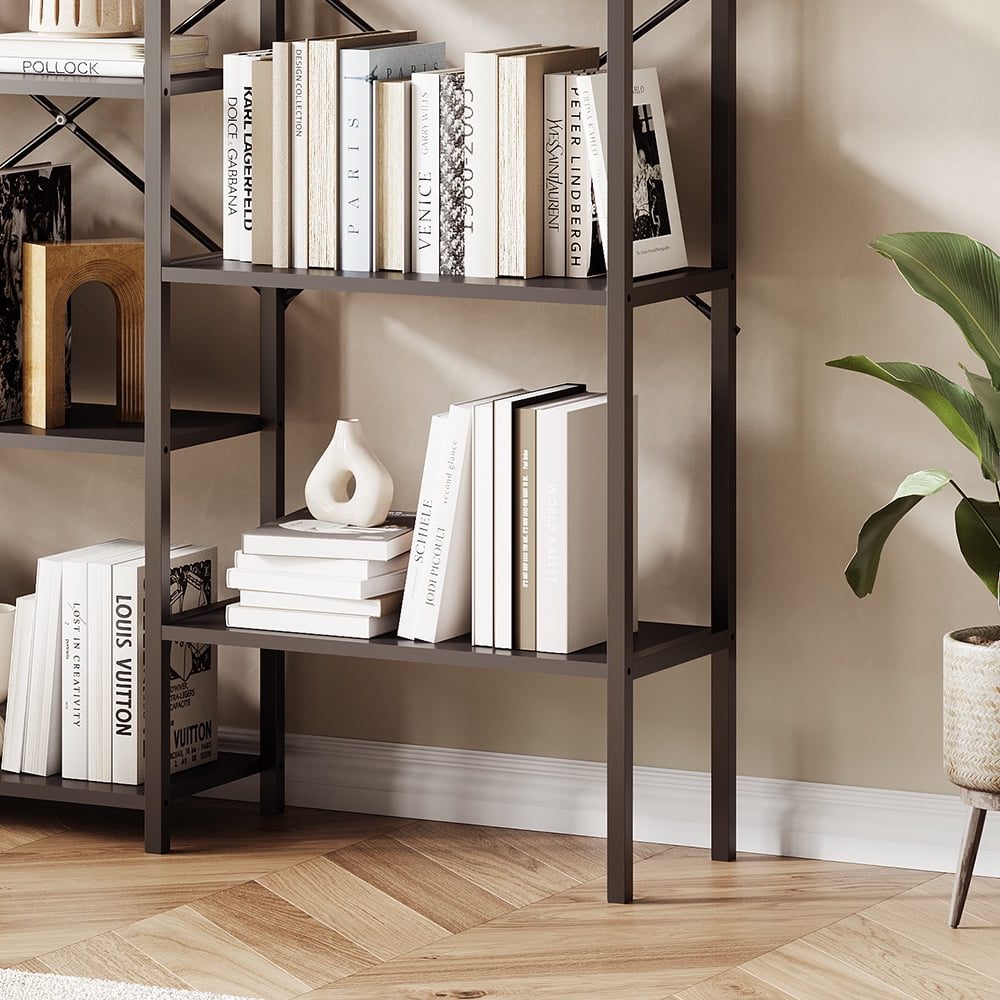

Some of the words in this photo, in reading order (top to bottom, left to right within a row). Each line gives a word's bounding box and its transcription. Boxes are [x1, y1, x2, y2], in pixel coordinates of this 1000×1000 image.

[22, 60, 100, 74] POLLOCK
[244, 86, 252, 130] KARL
[228, 148, 238, 216] GABBANA
[244, 133, 252, 231] LAGERFELD
[348, 118, 360, 235] PARIS
[418, 172, 432, 250] VENICE
[571, 156, 582, 266] LINDBERGH
[414, 499, 433, 564] SCHIELE
[429, 527, 446, 577] PICOULT
[116, 595, 132, 648] LOUIS
[426, 580, 437, 607] JODI
[73, 638, 80, 649] IN
[116, 658, 132, 737] VUITTON
[174, 720, 212, 748] VUITTON
